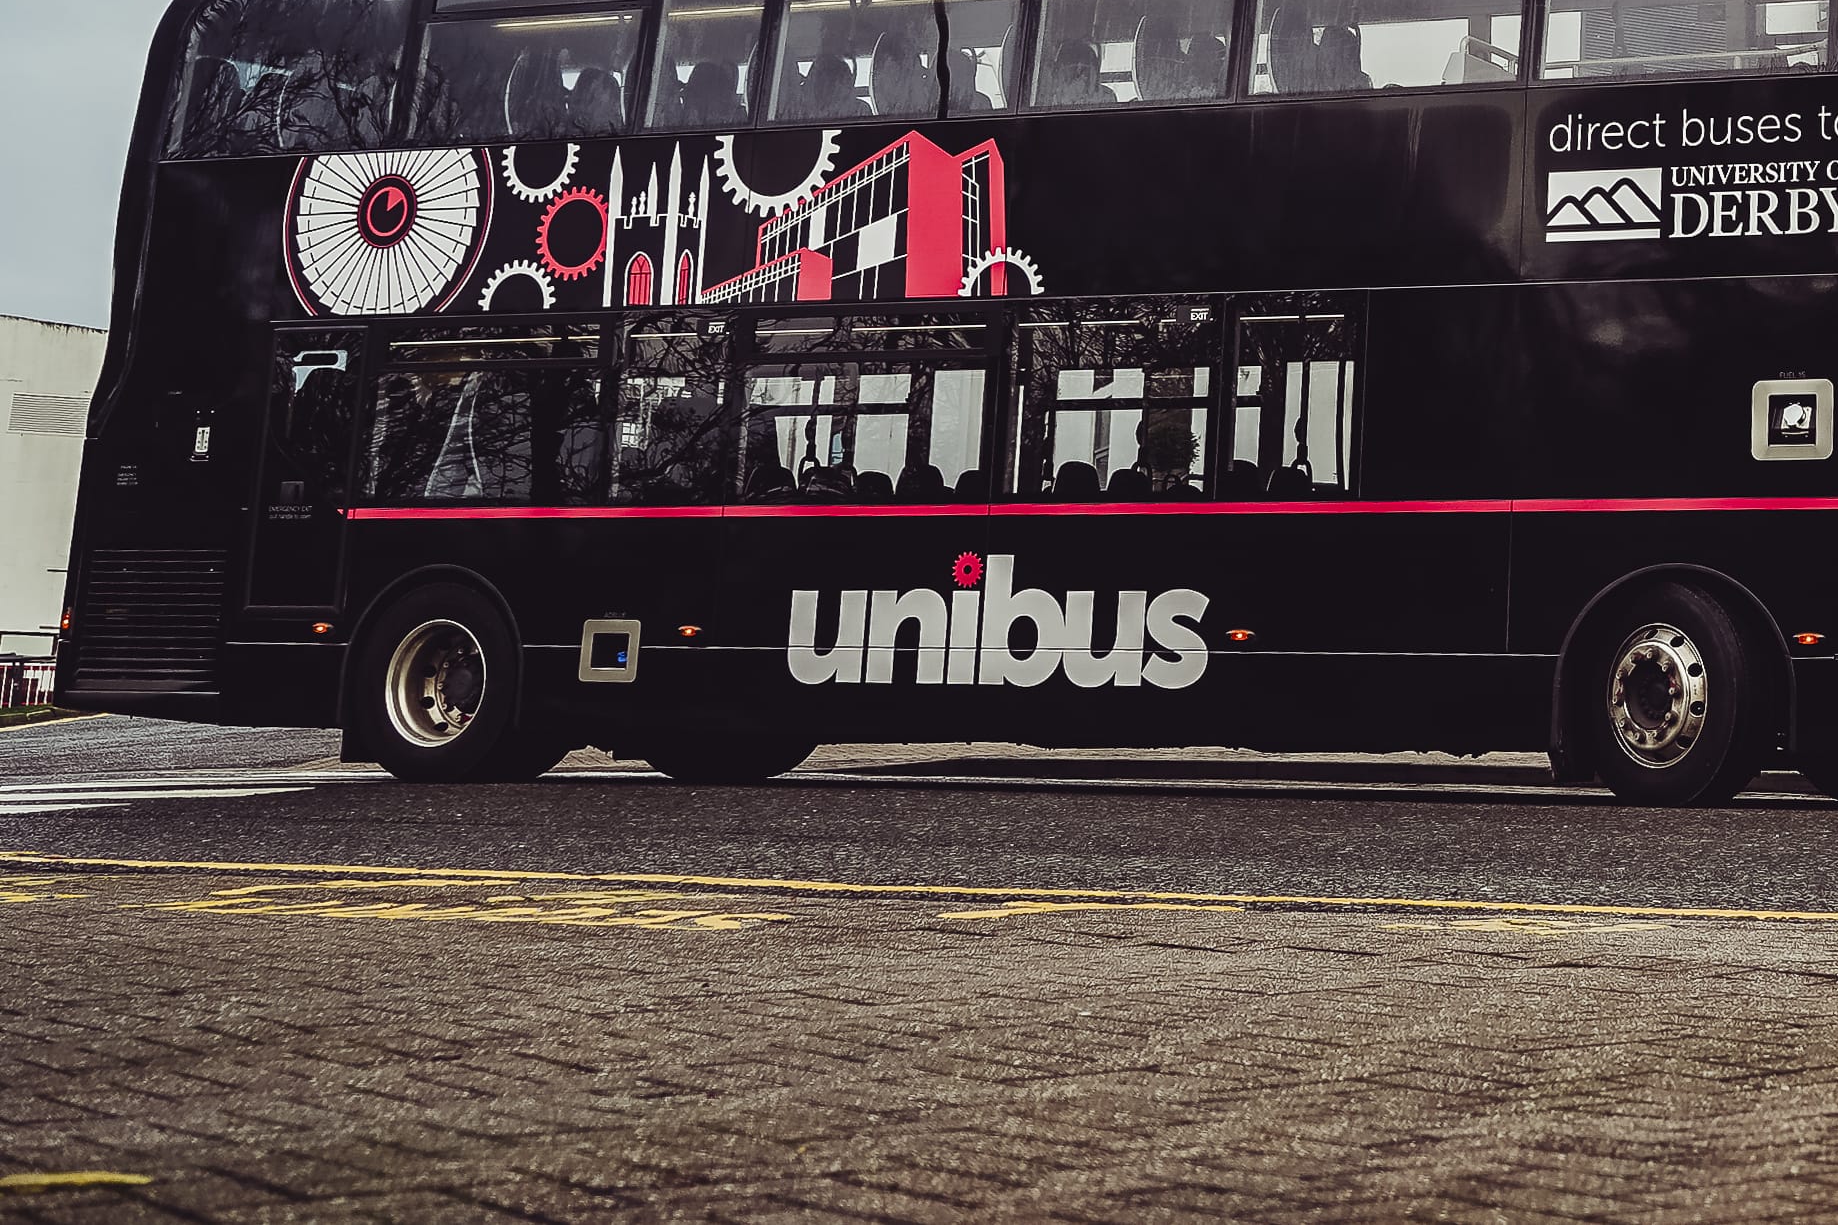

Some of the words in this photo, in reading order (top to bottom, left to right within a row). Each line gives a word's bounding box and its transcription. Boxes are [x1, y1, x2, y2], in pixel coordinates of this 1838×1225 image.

[1549, 112, 1666, 152] direct
[1682, 108, 1802, 147] buses
[1671, 161, 1821, 187] UNIVERSITY
[708, 325, 724, 333] EXIT
[1190, 312, 1208, 320] EXIT
[788, 551, 1210, 689] unibus
